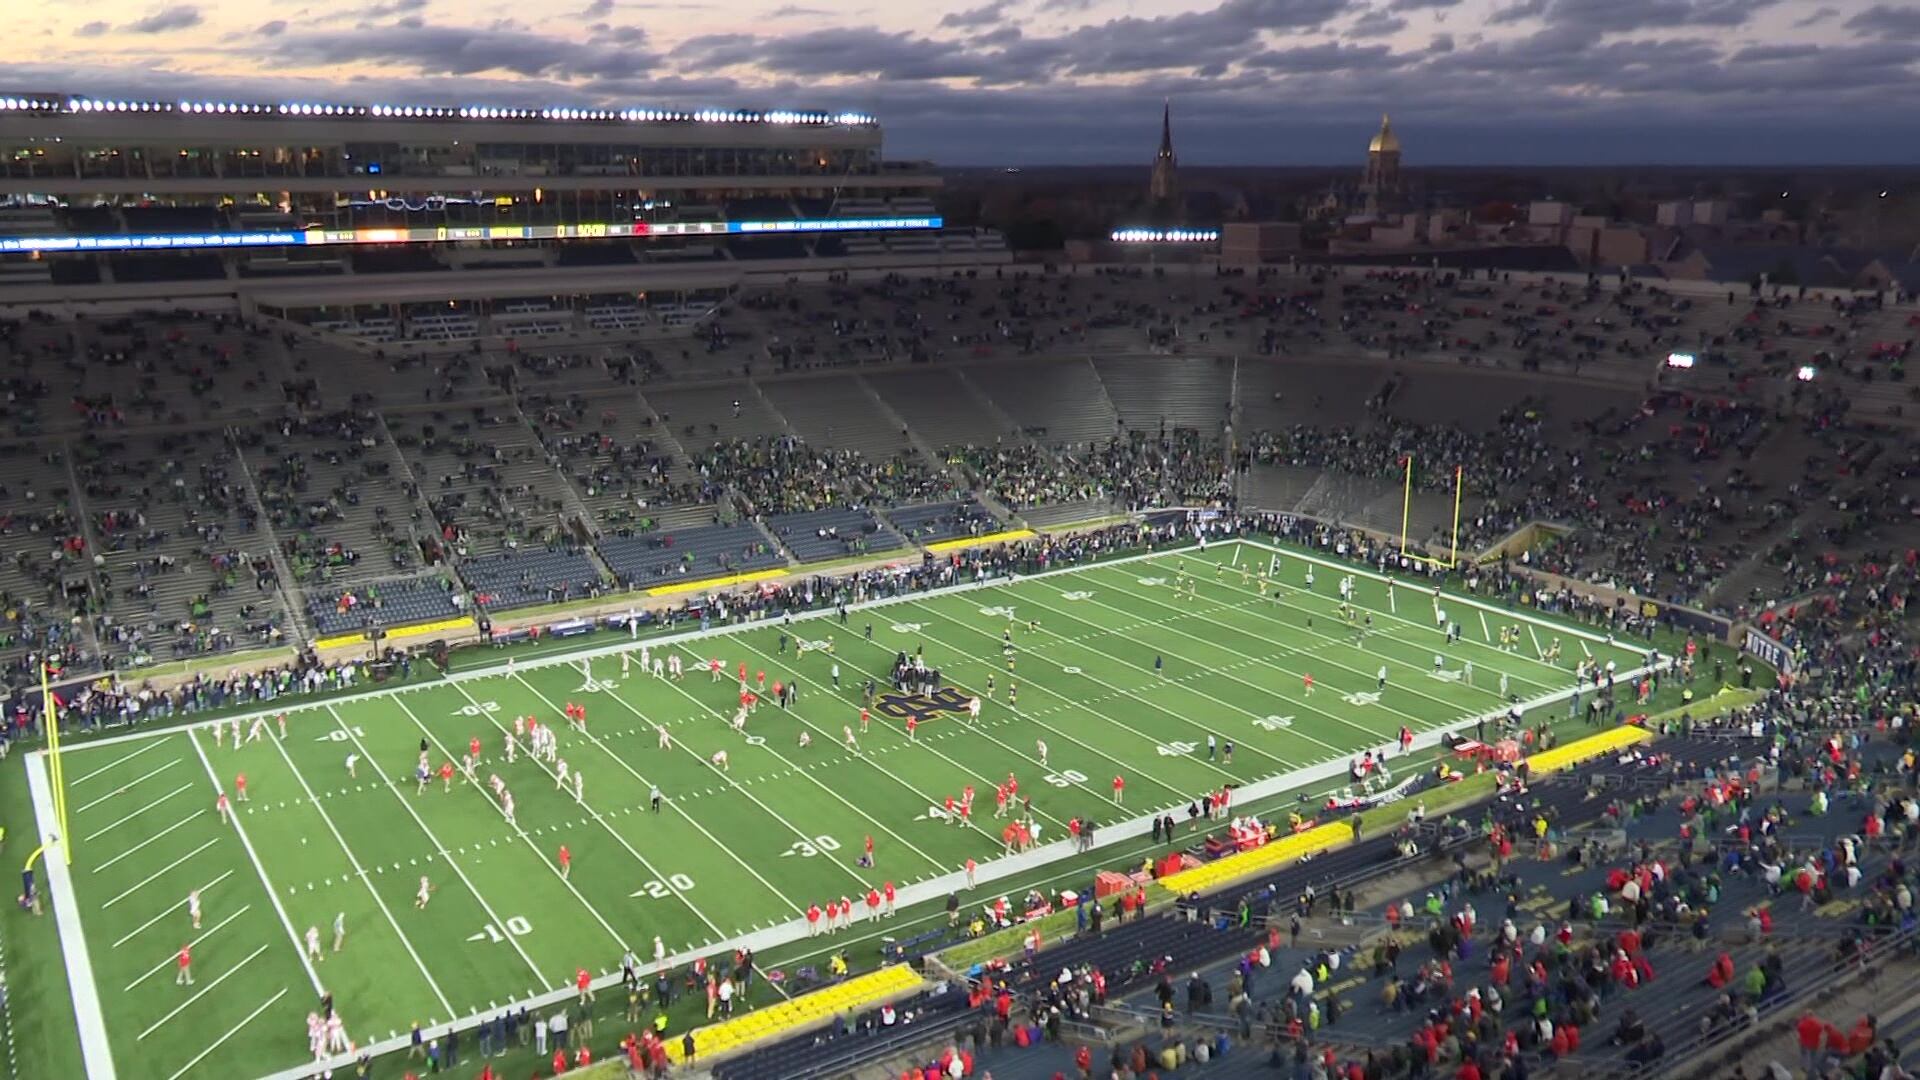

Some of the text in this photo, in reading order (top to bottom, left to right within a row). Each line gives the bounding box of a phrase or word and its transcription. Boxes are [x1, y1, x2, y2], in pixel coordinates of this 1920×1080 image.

[1746, 631, 1780, 667] NOTRE
[462, 701, 501, 716] 20
[328, 726, 366, 742] 10
[1042, 769, 1089, 788] 50
[792, 835, 842, 857] 30
[643, 873, 696, 899] 20
[483, 915, 533, 943] 10
